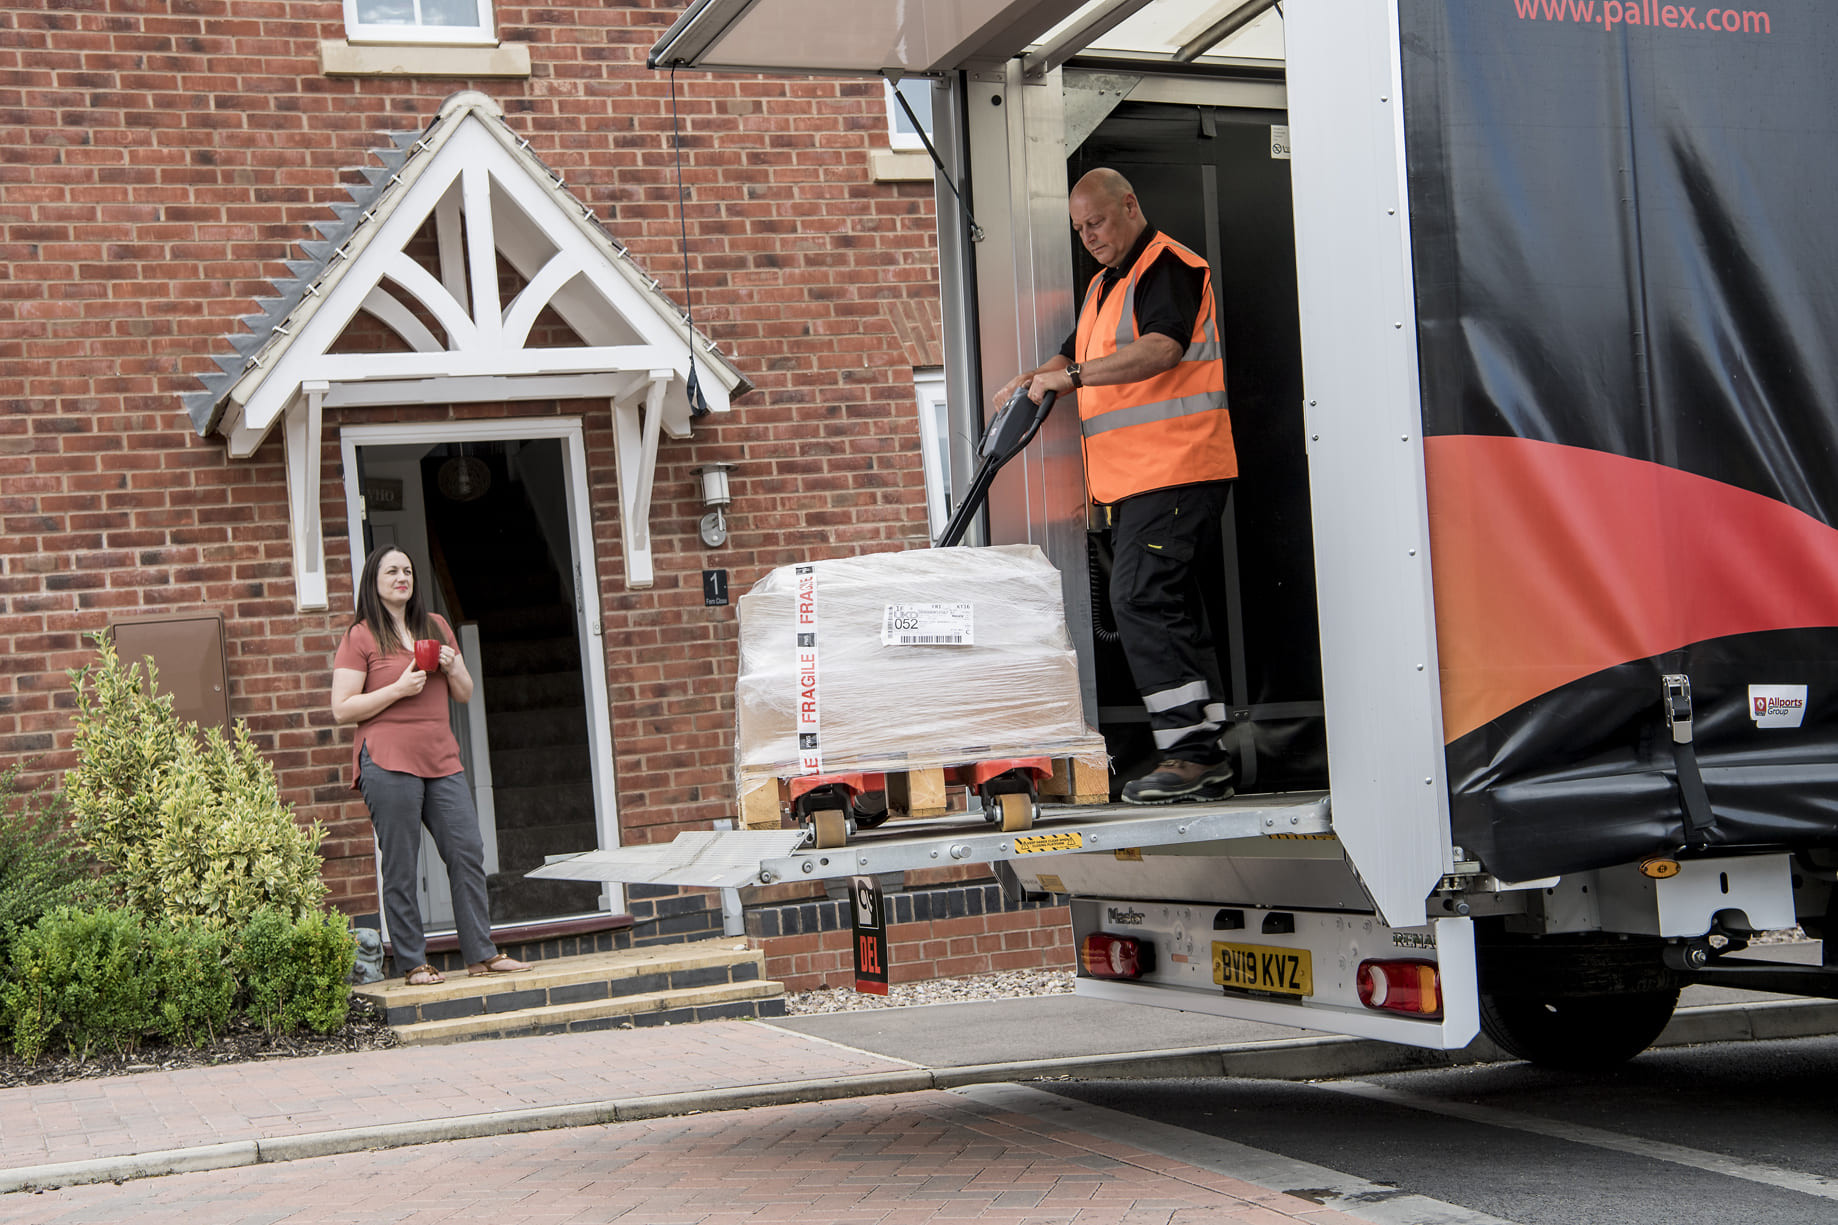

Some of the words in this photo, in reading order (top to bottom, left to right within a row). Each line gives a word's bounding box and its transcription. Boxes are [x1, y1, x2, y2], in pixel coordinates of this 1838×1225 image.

[1513, 0, 1771, 33] www.pallex.com
[710, 572, 719, 595] 1
[894, 618, 919, 630] 052
[801, 654, 816, 723] FRAGILE
[1767, 708, 1789, 716] Group
[1768, 697, 1803, 707] Allports
[1392, 931, 1436, 949] RENA
[859, 935, 881, 974] DEL
[1221, 949, 1257, 985] BV19
[1262, 952, 1300, 989] KVZ
